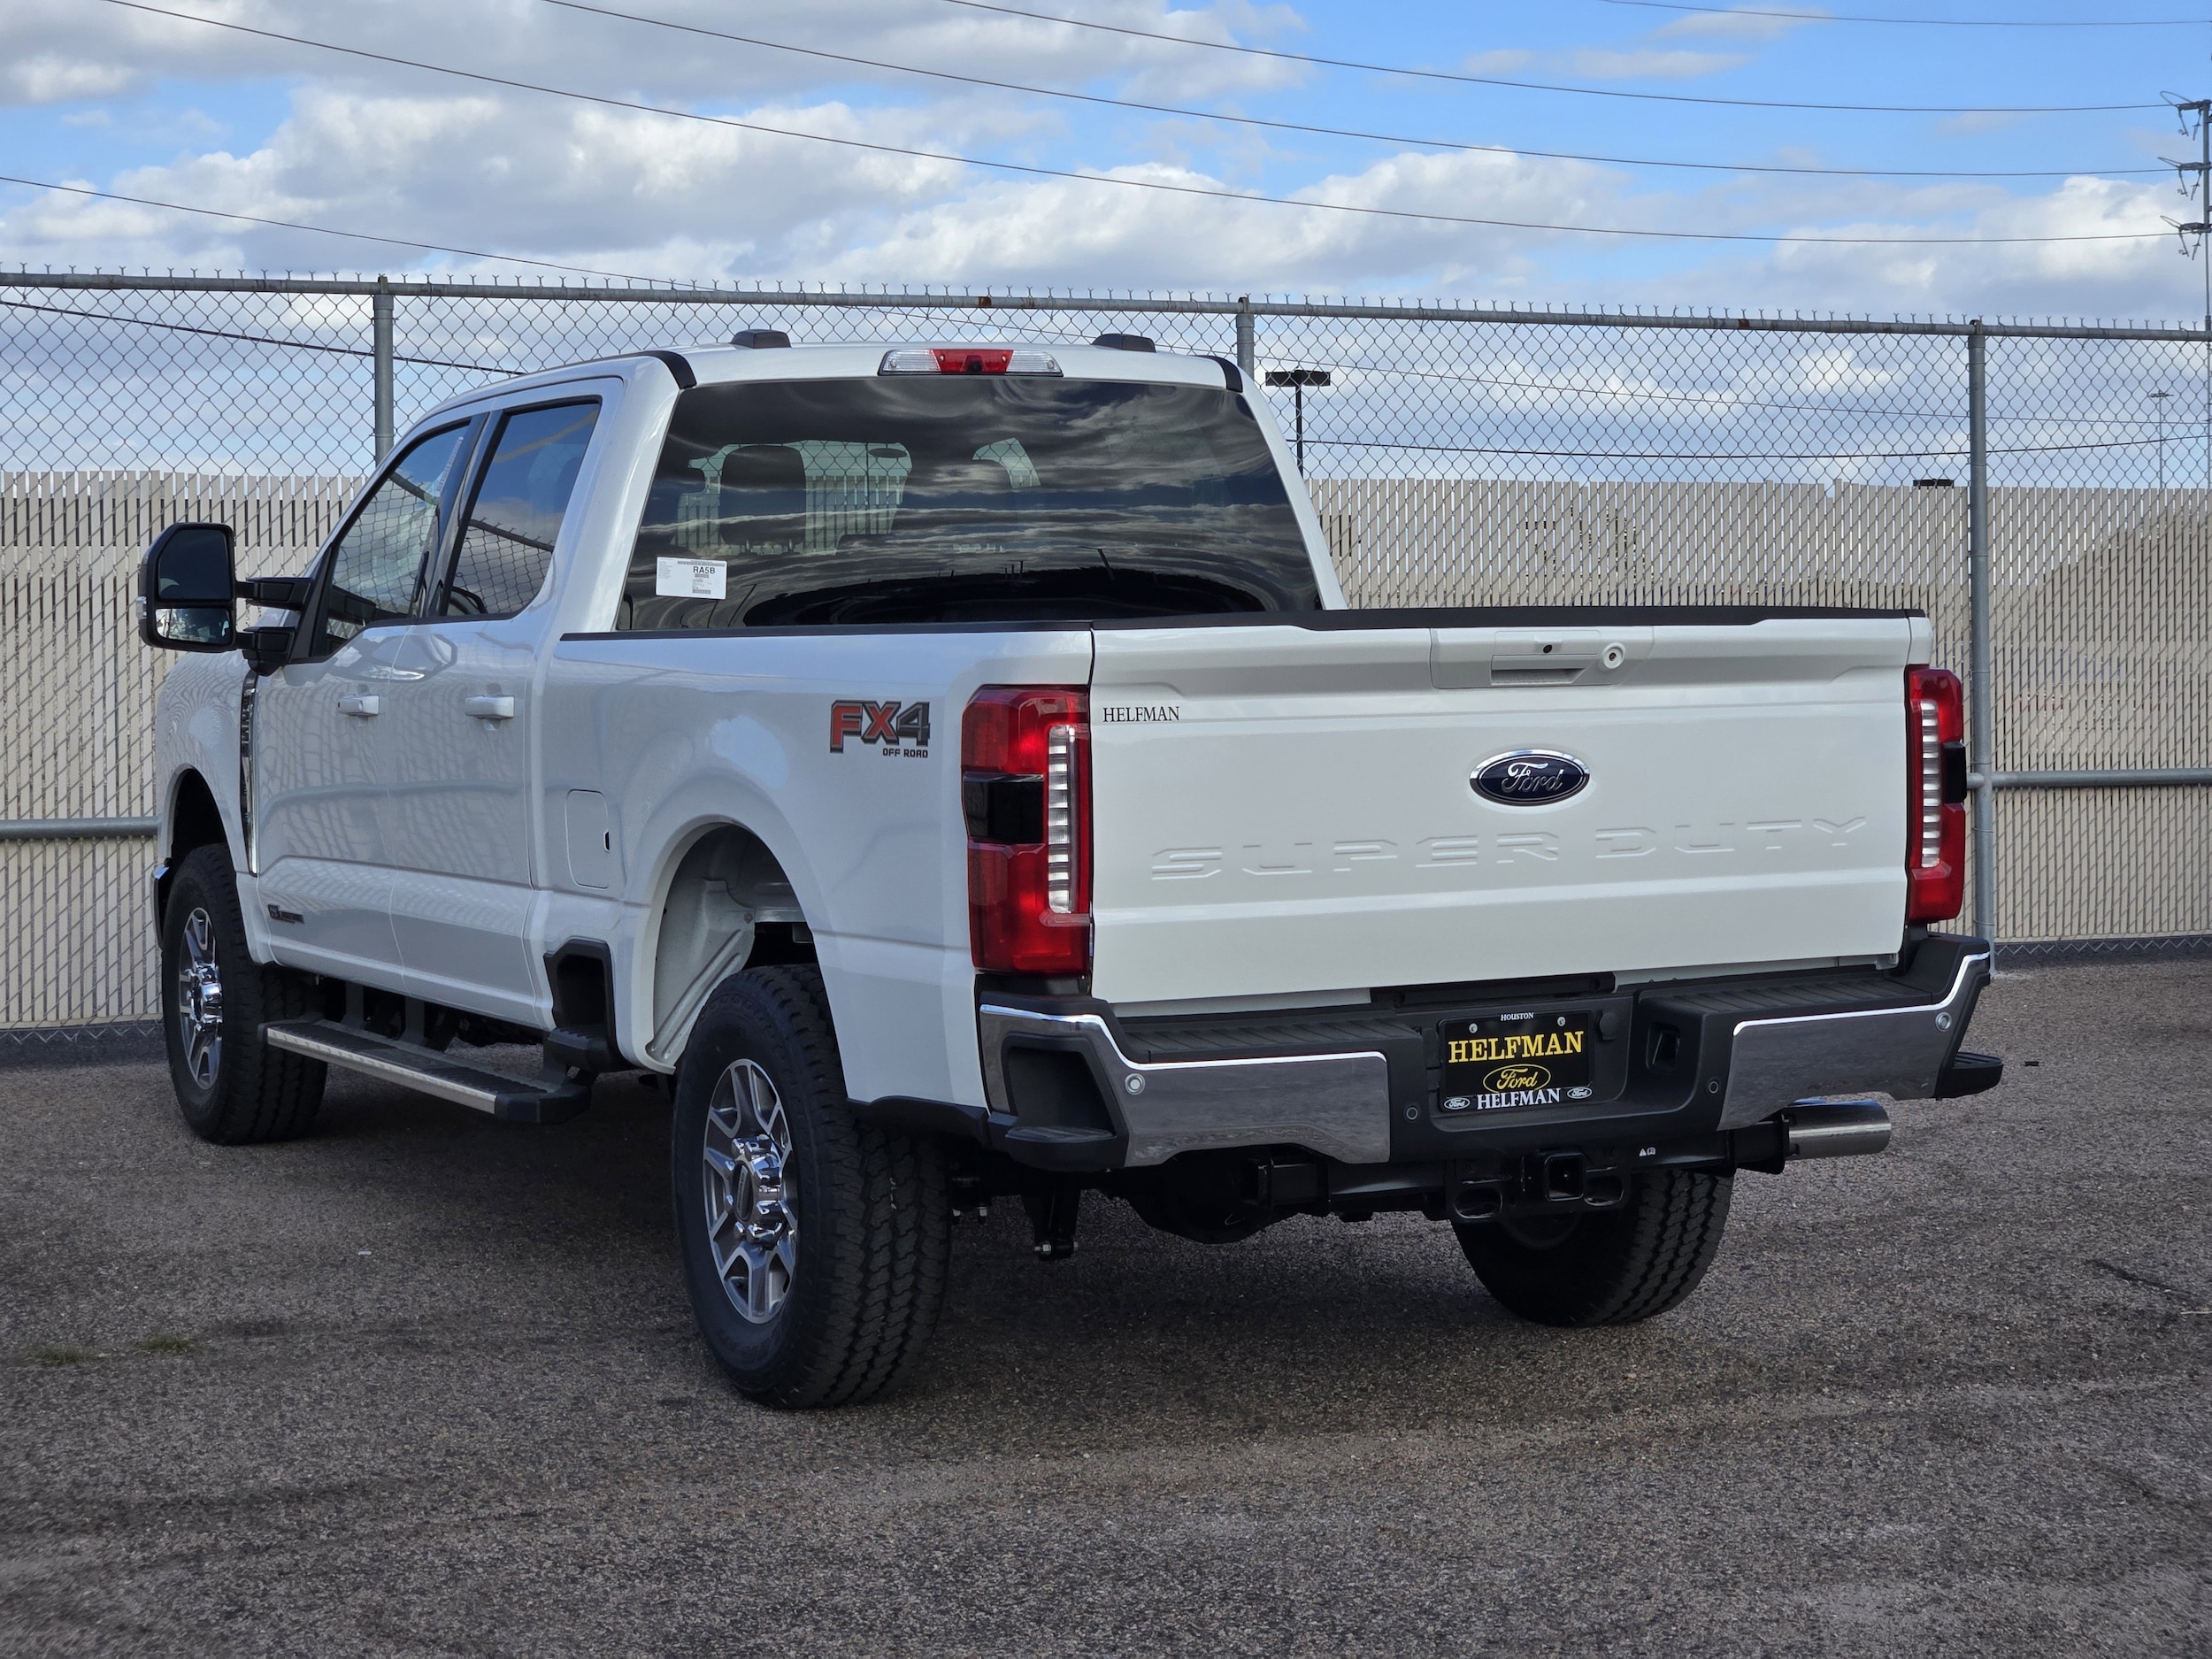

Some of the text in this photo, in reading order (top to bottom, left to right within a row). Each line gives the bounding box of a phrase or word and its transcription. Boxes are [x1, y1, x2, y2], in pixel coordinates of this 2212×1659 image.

[1102, 706, 1180, 723] HELFMAN
[830, 700, 930, 753] FX4
[882, 748, 928, 758] OFF ROAD
[1501, 762, 1564, 792] Ford
[1151, 816, 1866, 880] SUPER DUTY
[1500, 1012, 1535, 1021] HOUSTON
[1448, 1031, 1585, 1064] HELFMAN
[1495, 1067, 1539, 1090] Ford
[1476, 1087, 1561, 1110] HELFMAN
